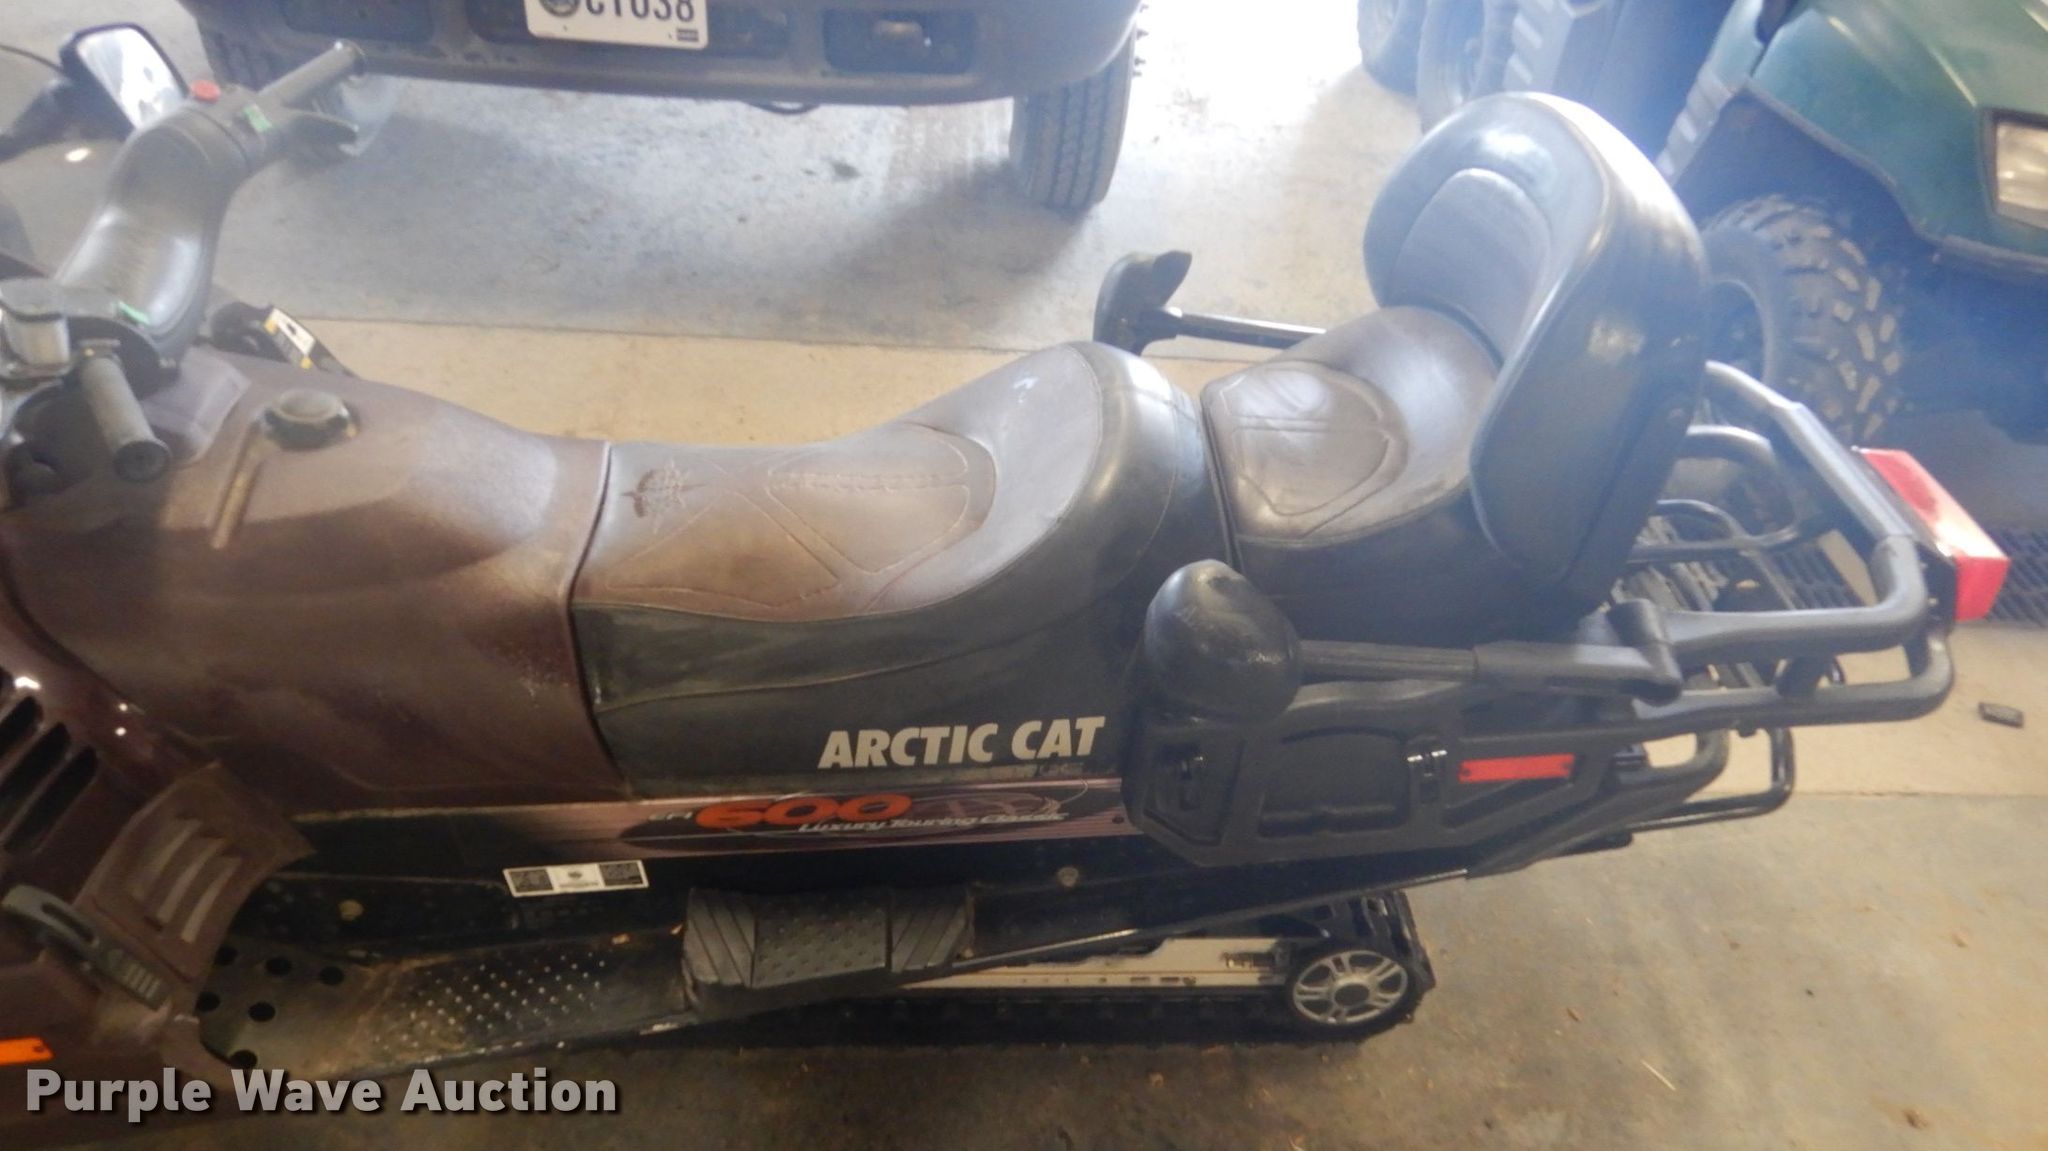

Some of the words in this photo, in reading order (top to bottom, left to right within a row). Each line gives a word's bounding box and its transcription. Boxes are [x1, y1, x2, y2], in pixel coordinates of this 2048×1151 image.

[817, 723, 999, 769] ARCTIC
[1011, 716, 1106, 760] CAT
[695, 792, 912, 829] 600
[798, 820, 887, 833] Luxury
